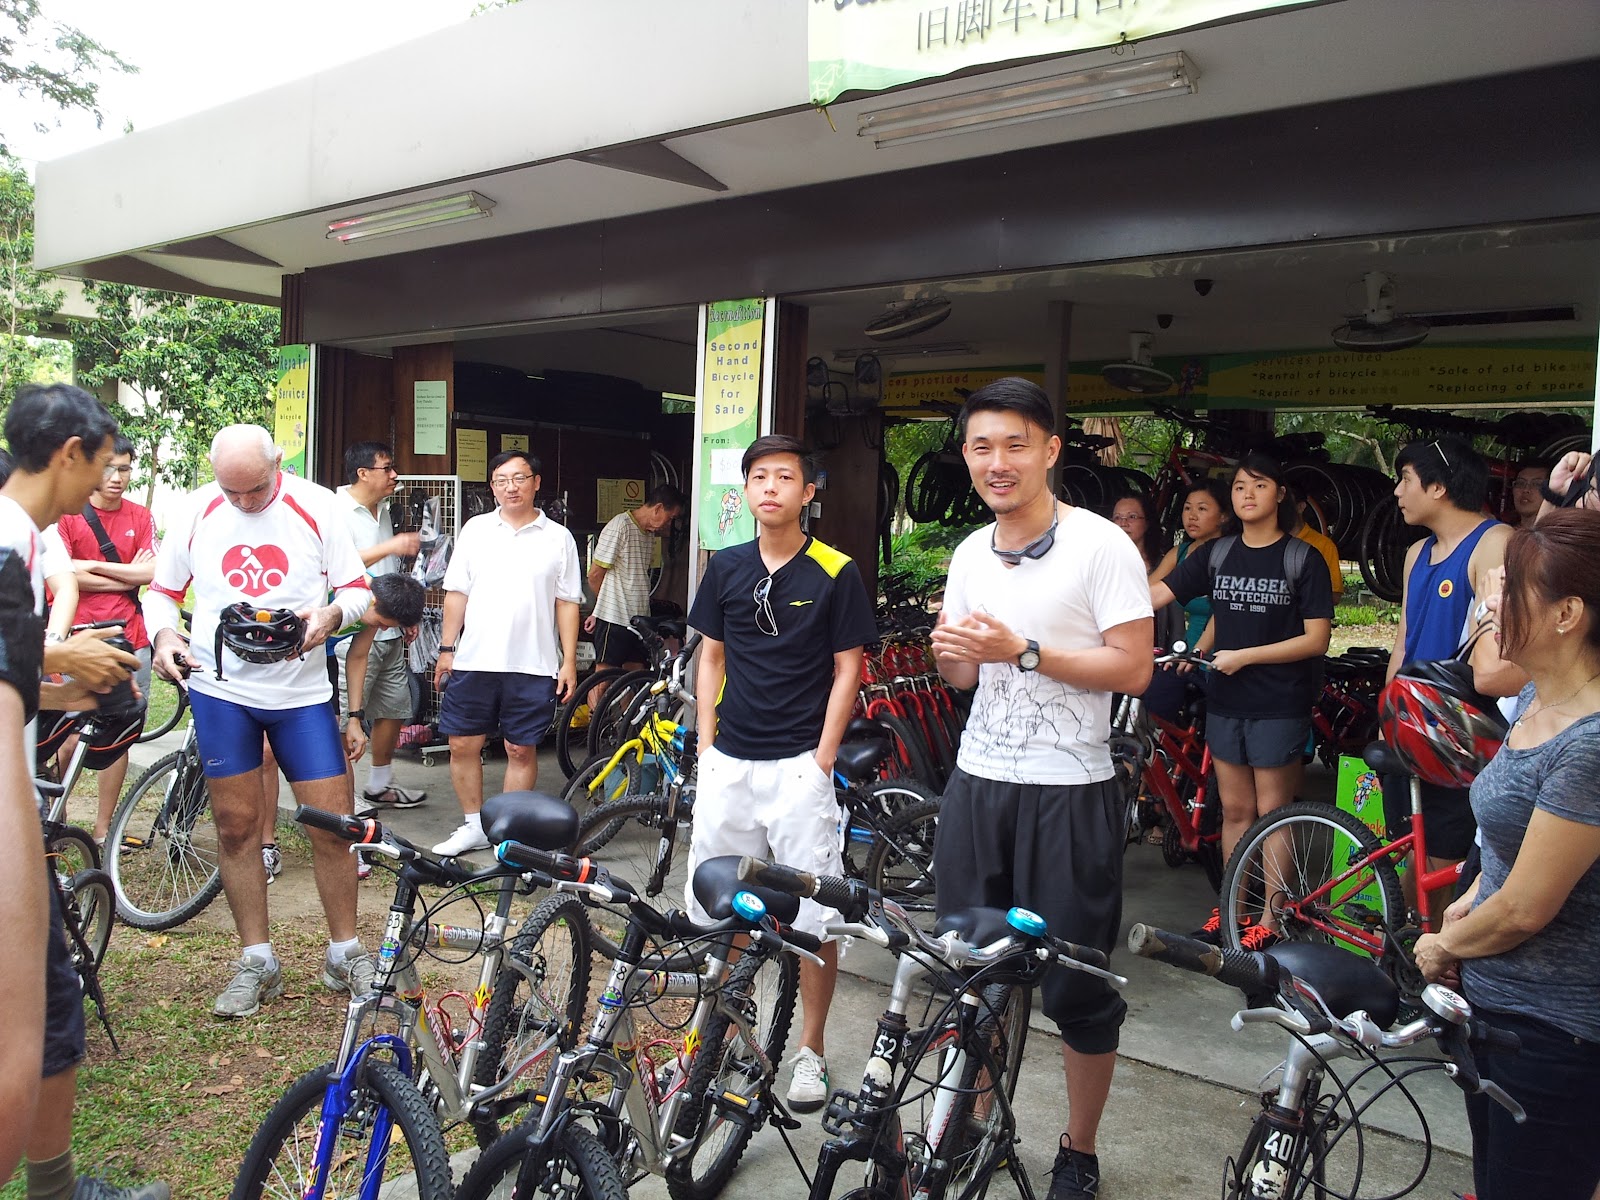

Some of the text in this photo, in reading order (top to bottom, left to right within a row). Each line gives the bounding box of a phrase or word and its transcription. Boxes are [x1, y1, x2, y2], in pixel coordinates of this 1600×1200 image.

[711, 340, 757, 351] Second
[279, 354, 307, 373] Repair
[717, 356, 748, 365] Hand
[1319, 353, 1382, 365] provided
[1308, 370, 1320, 379] of
[1329, 368, 1377, 379] bicycle
[1478, 365, 1493, 374] of
[1502, 364, 1524, 373] old
[1534, 363, 1566, 372] bike
[712, 373, 754, 382] Bicycle
[913, 374, 969, 387] provided
[1308, 387, 1320, 396] of
[1329, 386, 1356, 395] bike
[1516, 382, 1531, 391] of
[1542, 382, 1584, 392] spare
[278, 388, 305, 399] Service
[721, 389, 739, 398] for
[911, 391, 945, 399] bicycle
[716, 405, 744, 414] Sale
[1214, 575, 1291, 594] TEMASEK
[1212, 589, 1291, 606] POLYTECHNIC
[1229, 602, 1267, 613] EST. 1990
[873, 1034, 897, 1060] 52
[1264, 1130, 1294, 1161] 40
